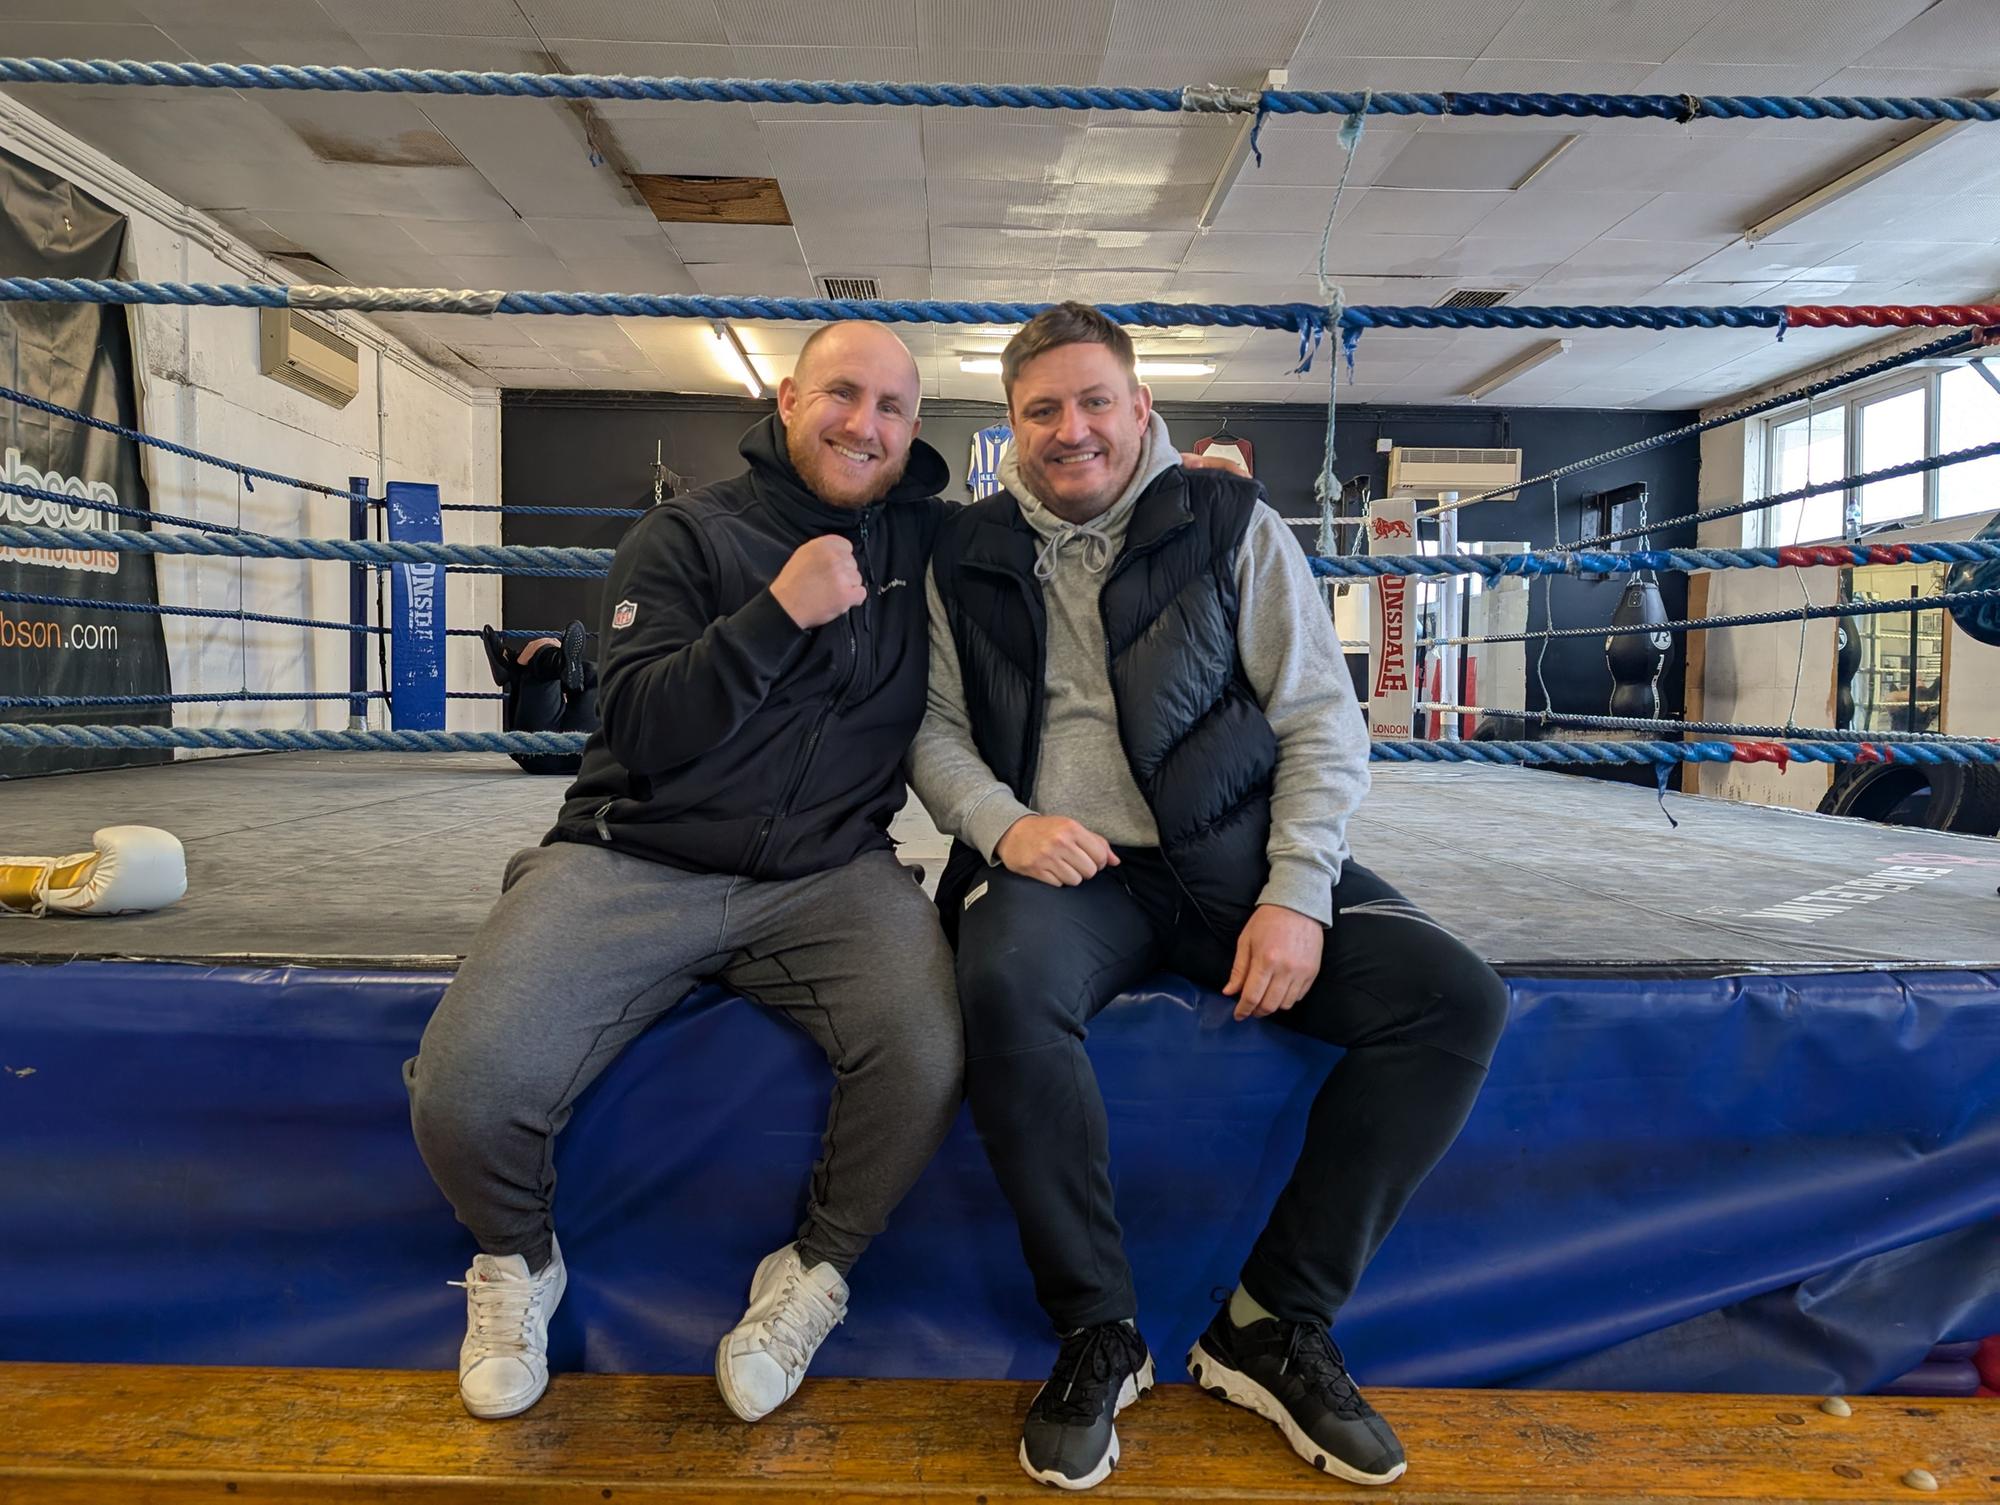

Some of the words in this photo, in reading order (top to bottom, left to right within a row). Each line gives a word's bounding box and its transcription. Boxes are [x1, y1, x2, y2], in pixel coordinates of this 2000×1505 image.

[0, 448, 118, 532] bson
[1379, 574, 1408, 691] ONSDALE
[1372, 724, 1409, 734] LONDON
